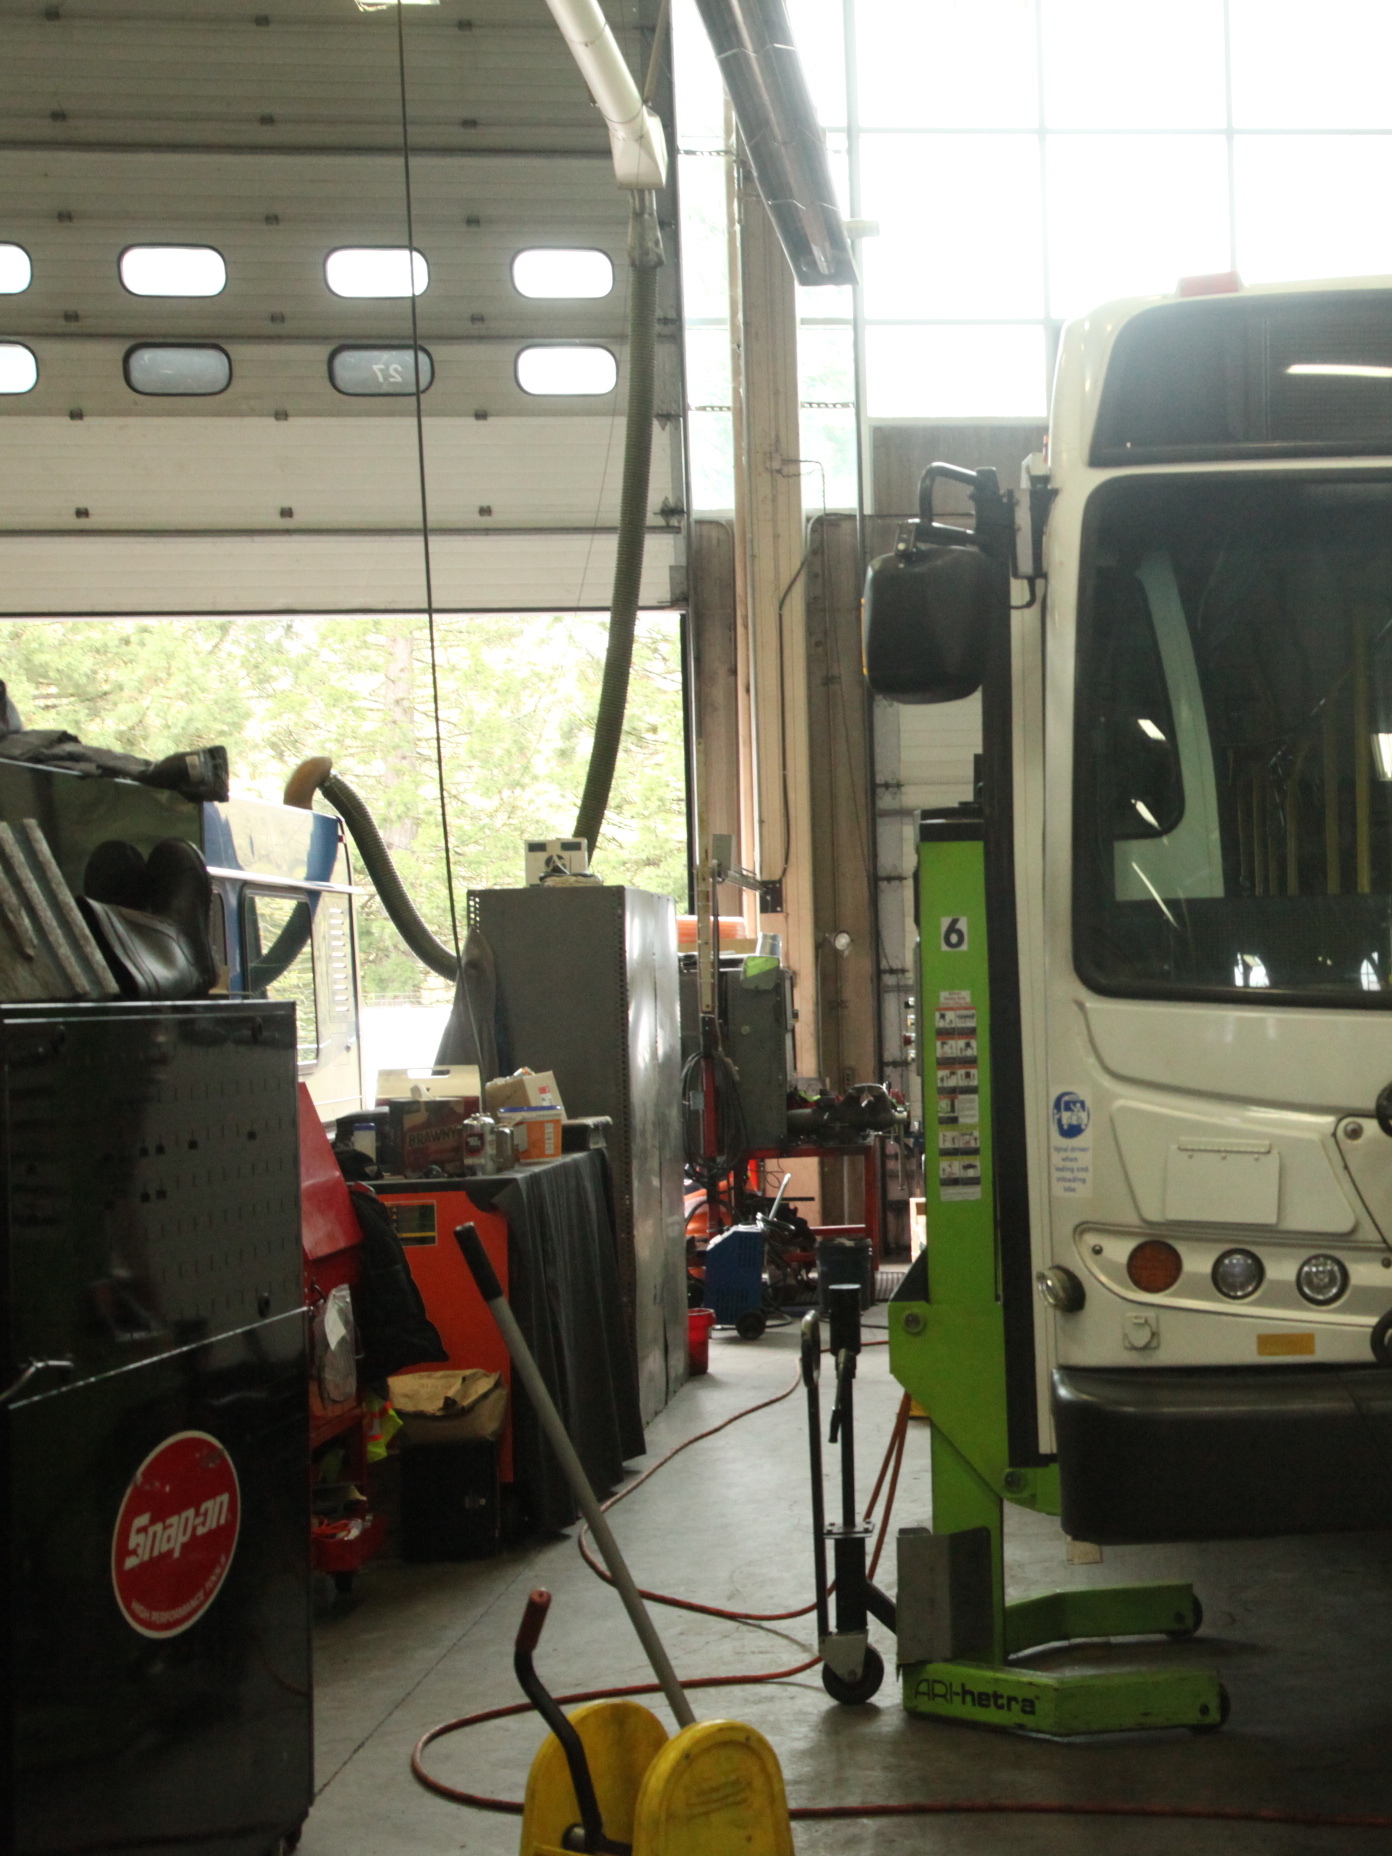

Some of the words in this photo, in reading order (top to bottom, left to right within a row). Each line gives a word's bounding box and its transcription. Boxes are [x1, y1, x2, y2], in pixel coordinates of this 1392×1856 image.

[943, 917, 965, 949] 6
[408, 1125, 459, 1147] BRAWNY
[123, 1492, 230, 1571] Snap-on
[914, 1678, 1037, 1716] ARI-hetra
